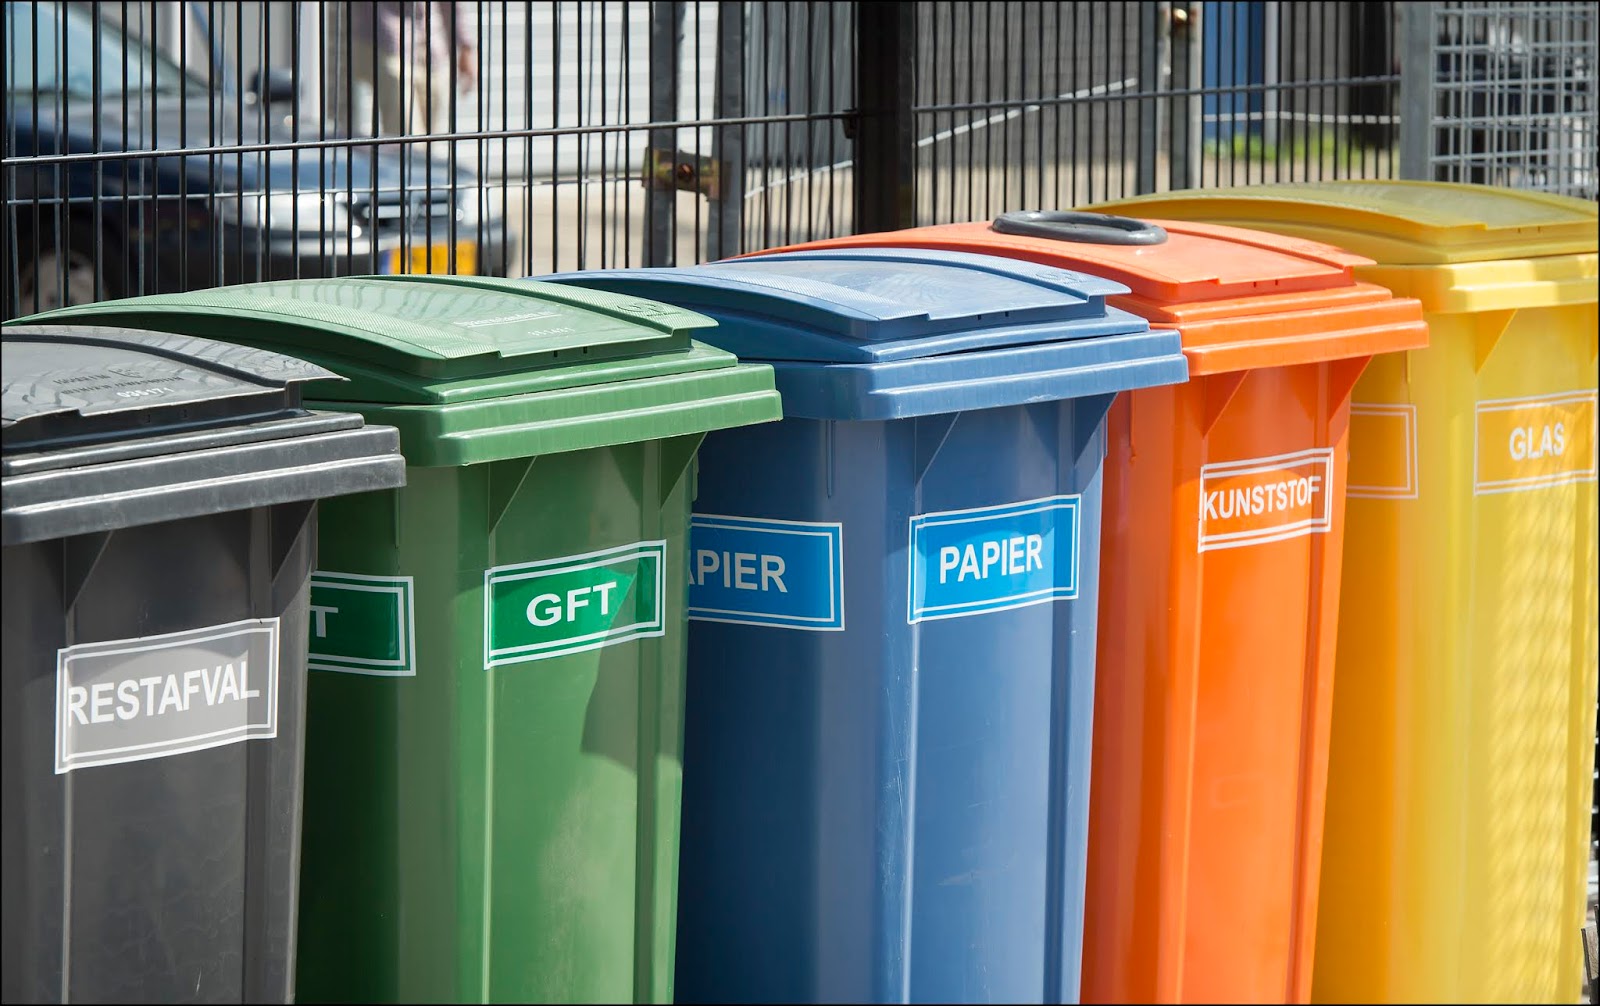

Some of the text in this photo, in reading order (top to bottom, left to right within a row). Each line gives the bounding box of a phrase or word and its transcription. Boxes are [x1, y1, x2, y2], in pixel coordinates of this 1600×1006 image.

[1508, 423, 1565, 461] GLAS
[1203, 475, 1321, 520] KUNSTSTOF
[939, 533, 1043, 584] PAPIER
[526, 582, 617, 627] GFT
[68, 661, 260, 727] RESTAFVAL
